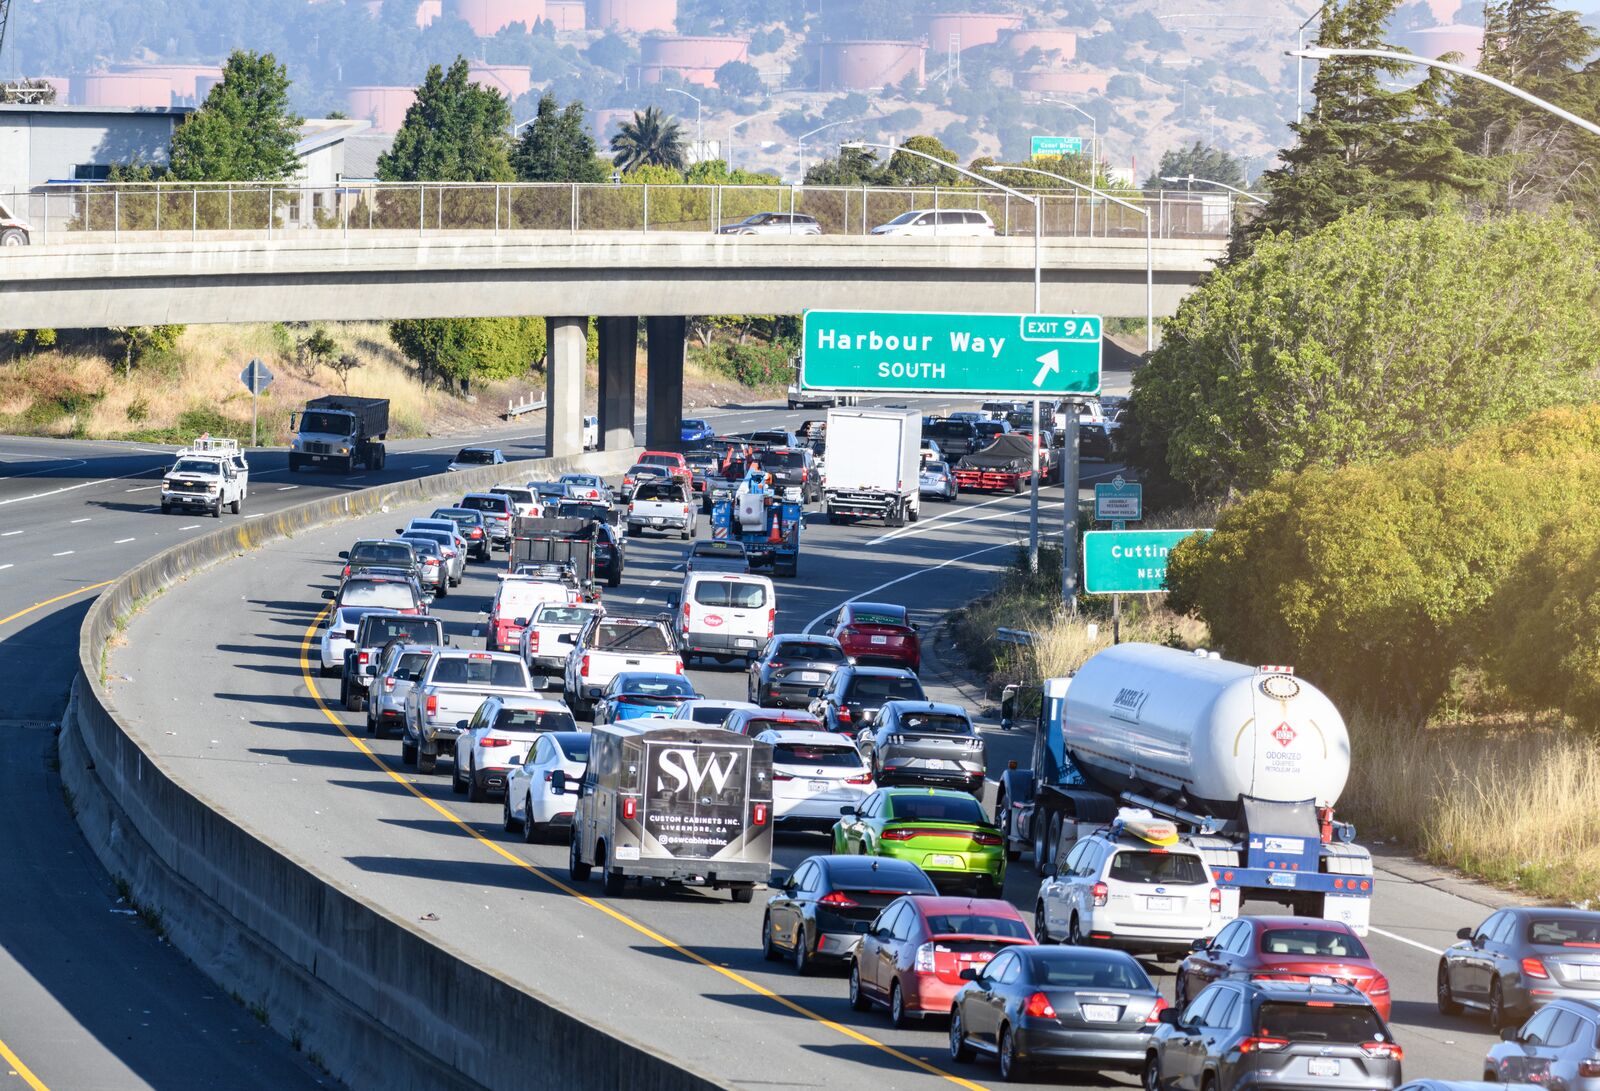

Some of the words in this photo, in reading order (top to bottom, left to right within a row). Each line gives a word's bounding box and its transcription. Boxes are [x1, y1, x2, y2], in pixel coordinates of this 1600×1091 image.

[1027, 321, 1059, 334] EXIT
[1063, 319, 1095, 337] 9A
[817, 328, 933, 352] Harbour
[949, 331, 1006, 358] Way
[877, 362, 946, 379] SOUTH
[1111, 544, 1168, 558] Cuttin
[1265, 751, 1302, 761] ODORIZED
[657, 748, 738, 795] SW
[649, 814, 681, 823] CUSTOM
[683, 816, 722, 825] CABINETS
[724, 818, 741, 826] INC.
[668, 835, 728, 846] @swcabinetsinc
